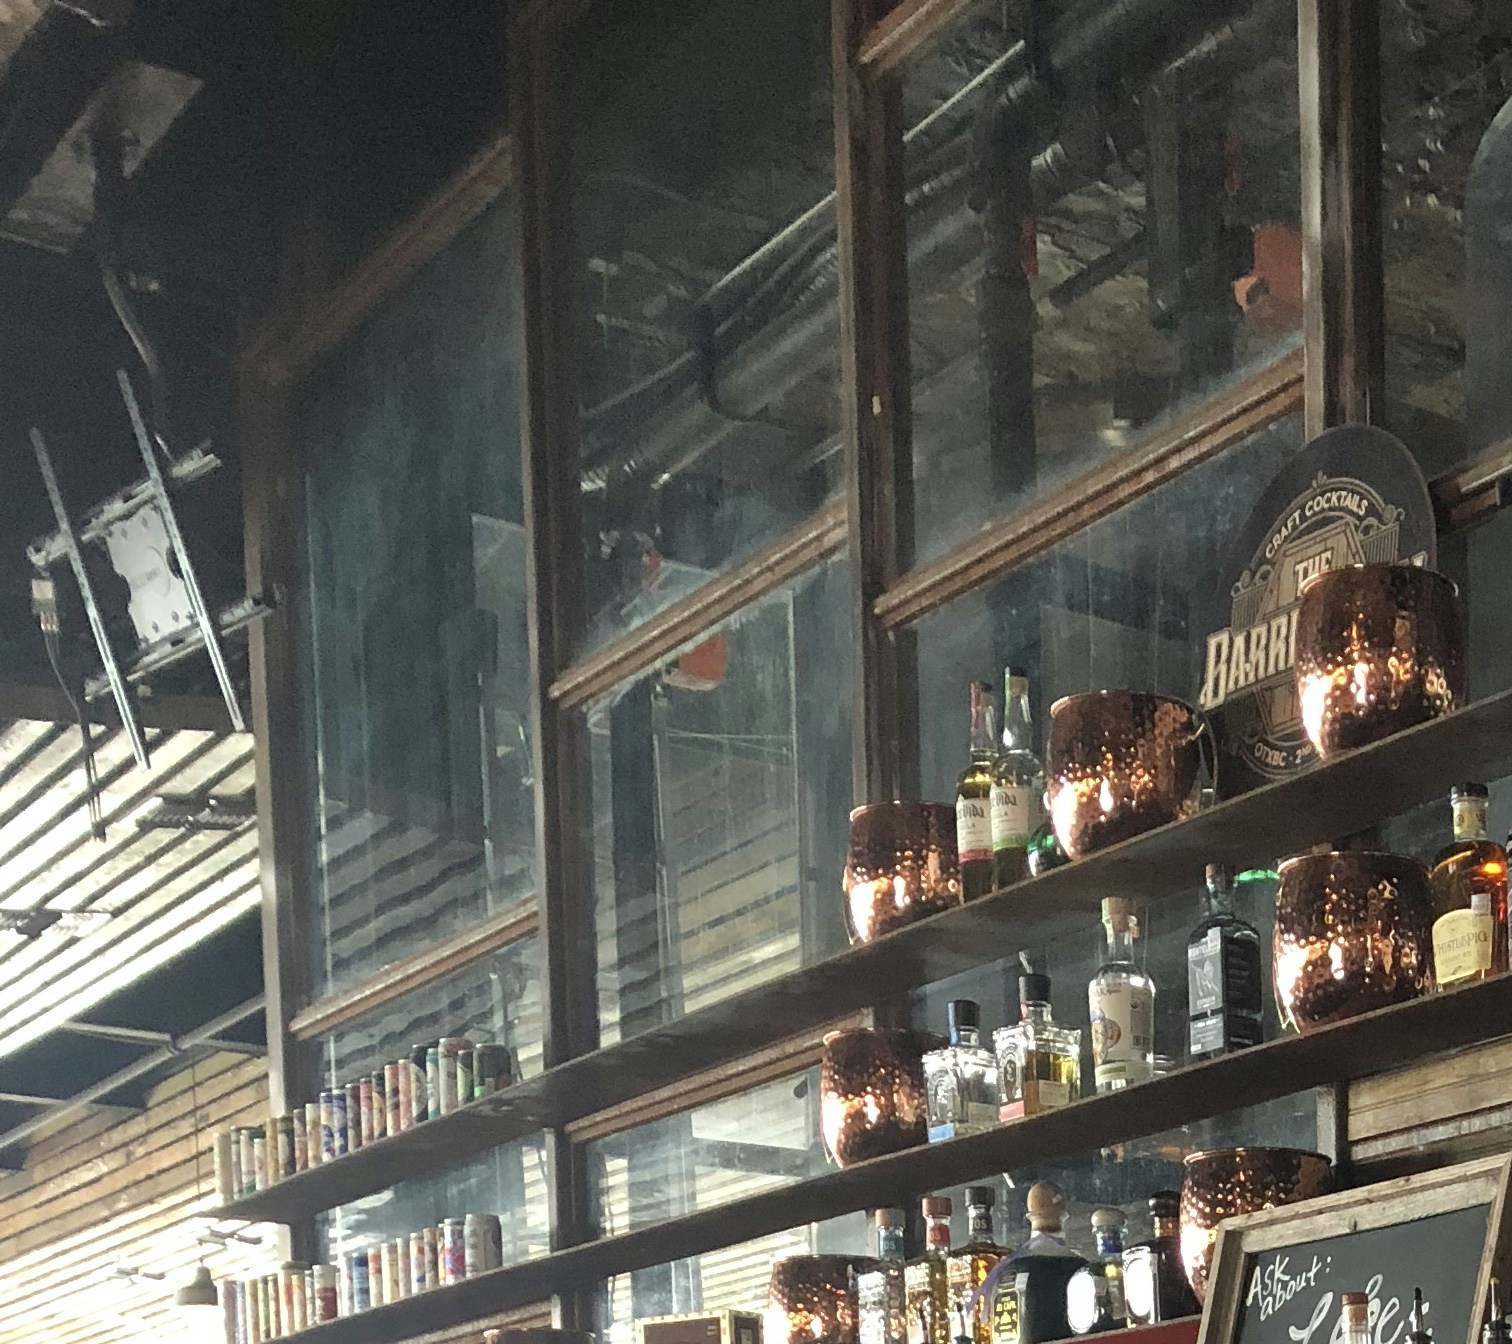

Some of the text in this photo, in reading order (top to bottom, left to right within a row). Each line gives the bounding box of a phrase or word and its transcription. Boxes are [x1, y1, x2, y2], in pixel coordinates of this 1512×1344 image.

[1265, 490, 1369, 559] CRAFT COCKTAILS
[1294, 547, 1333, 590] THE
[1246, 1254, 1291, 1306] Ask
